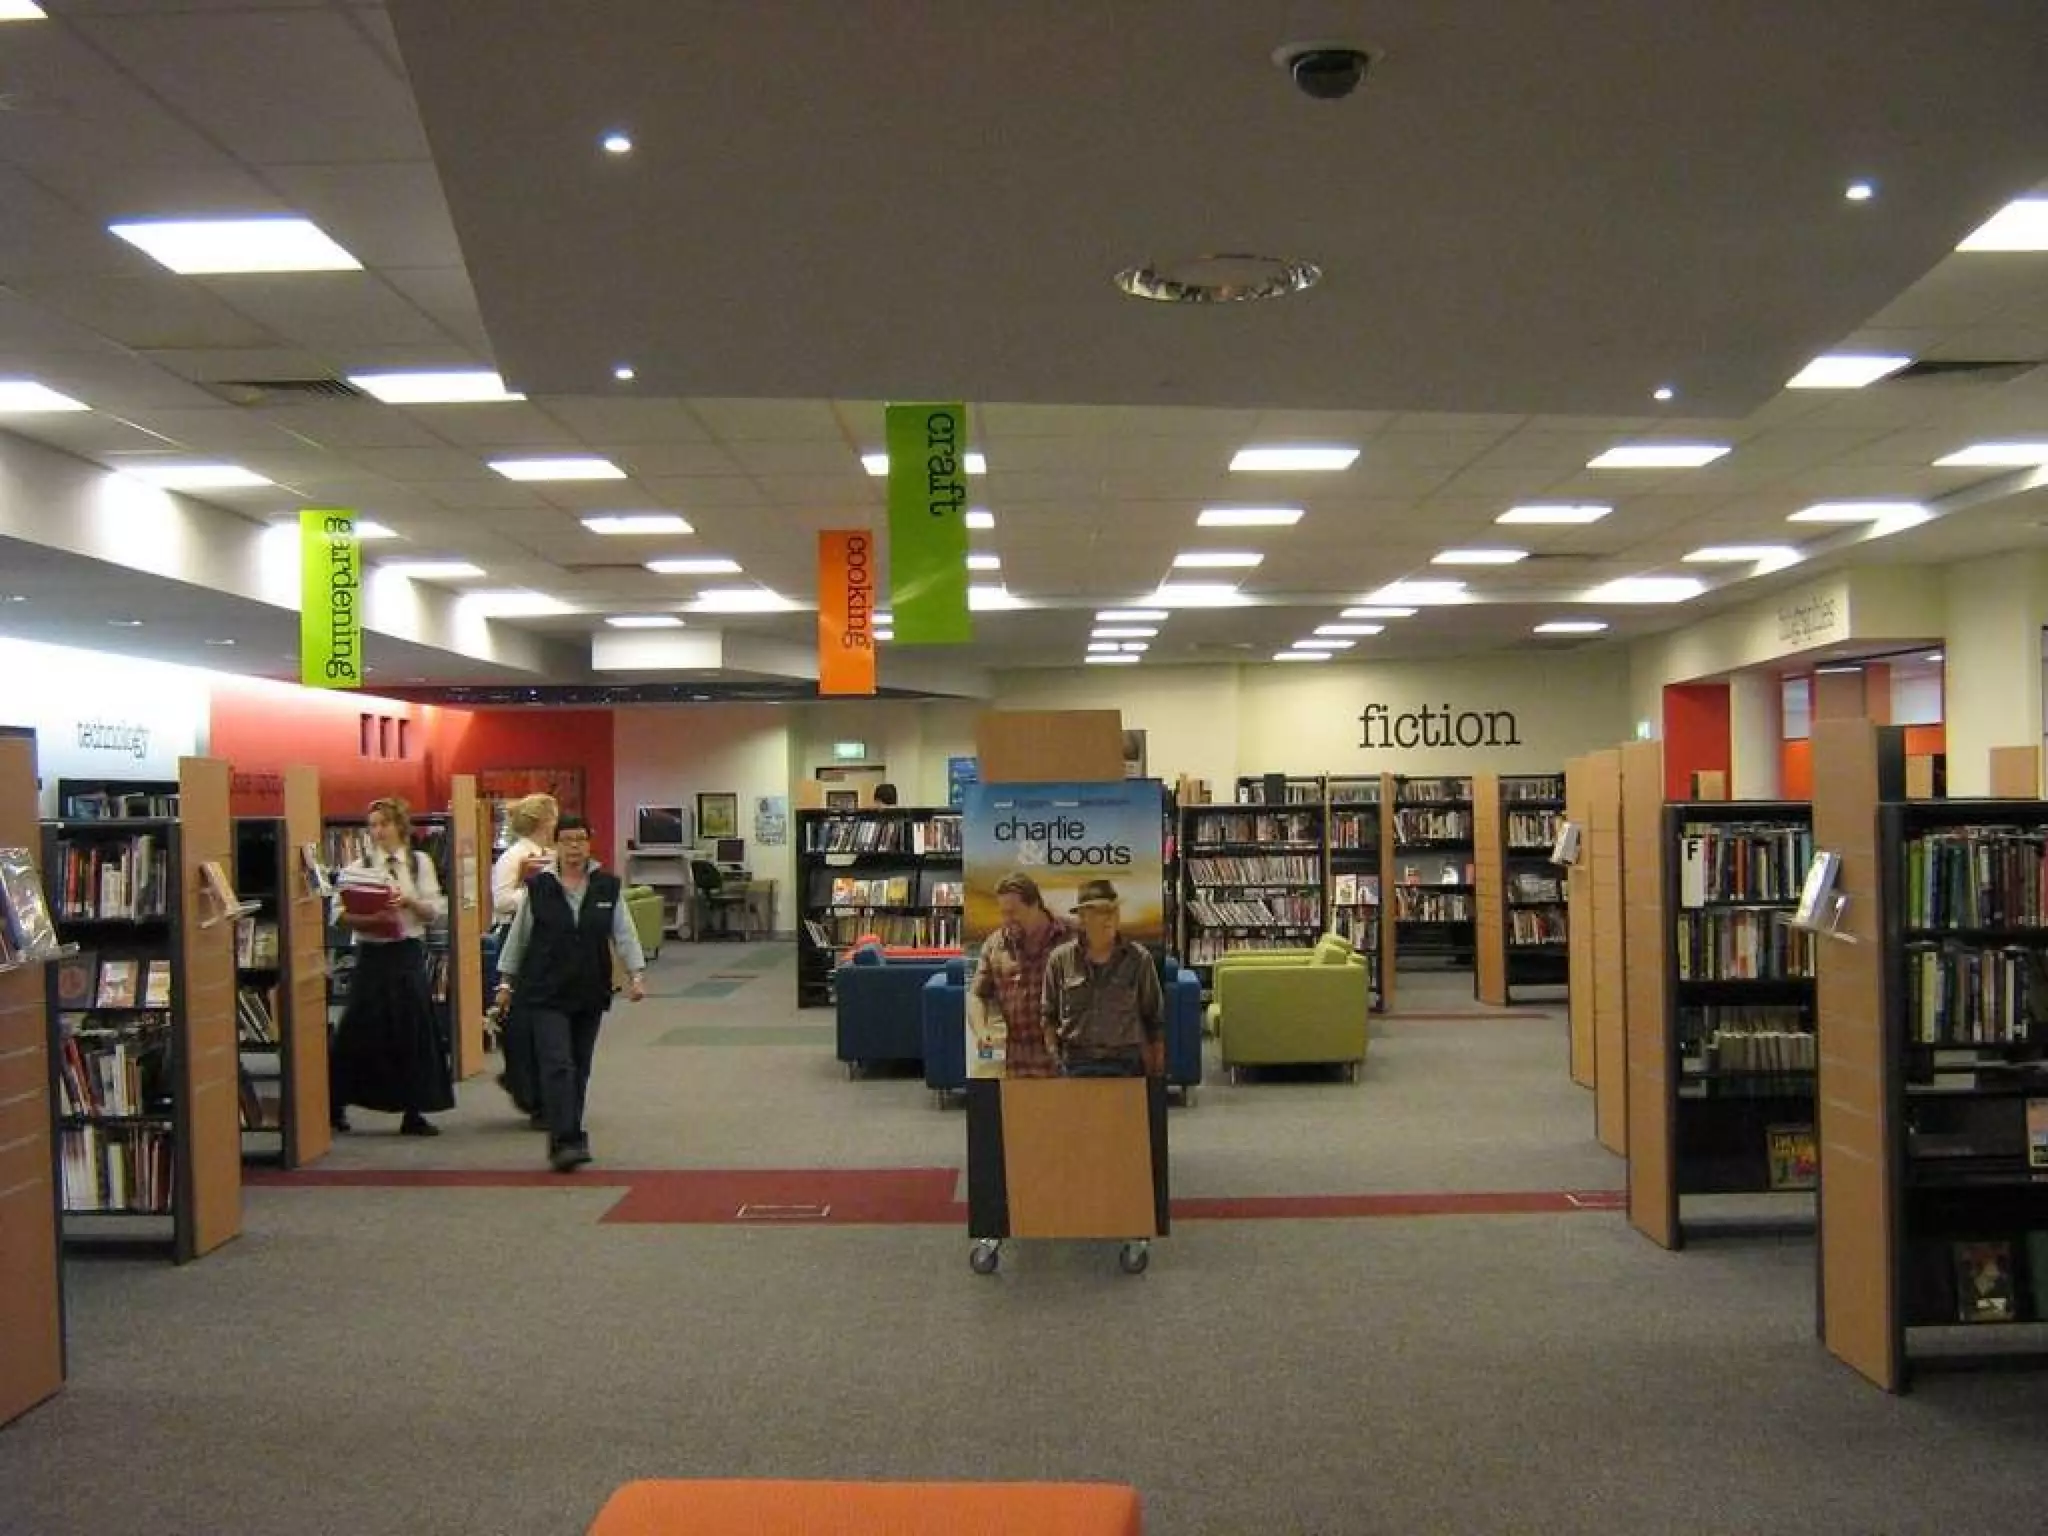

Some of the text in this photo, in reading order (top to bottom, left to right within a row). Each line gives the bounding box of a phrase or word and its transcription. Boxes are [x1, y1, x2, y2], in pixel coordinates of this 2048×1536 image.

[928, 412, 966, 516] craft
[842, 536, 873, 650] cooking
[1358, 703, 1521, 749] fiction
[994, 815, 1085, 841] charlie
[1047, 841, 1132, 865] boots
[1687, 839, 1699, 861] F
